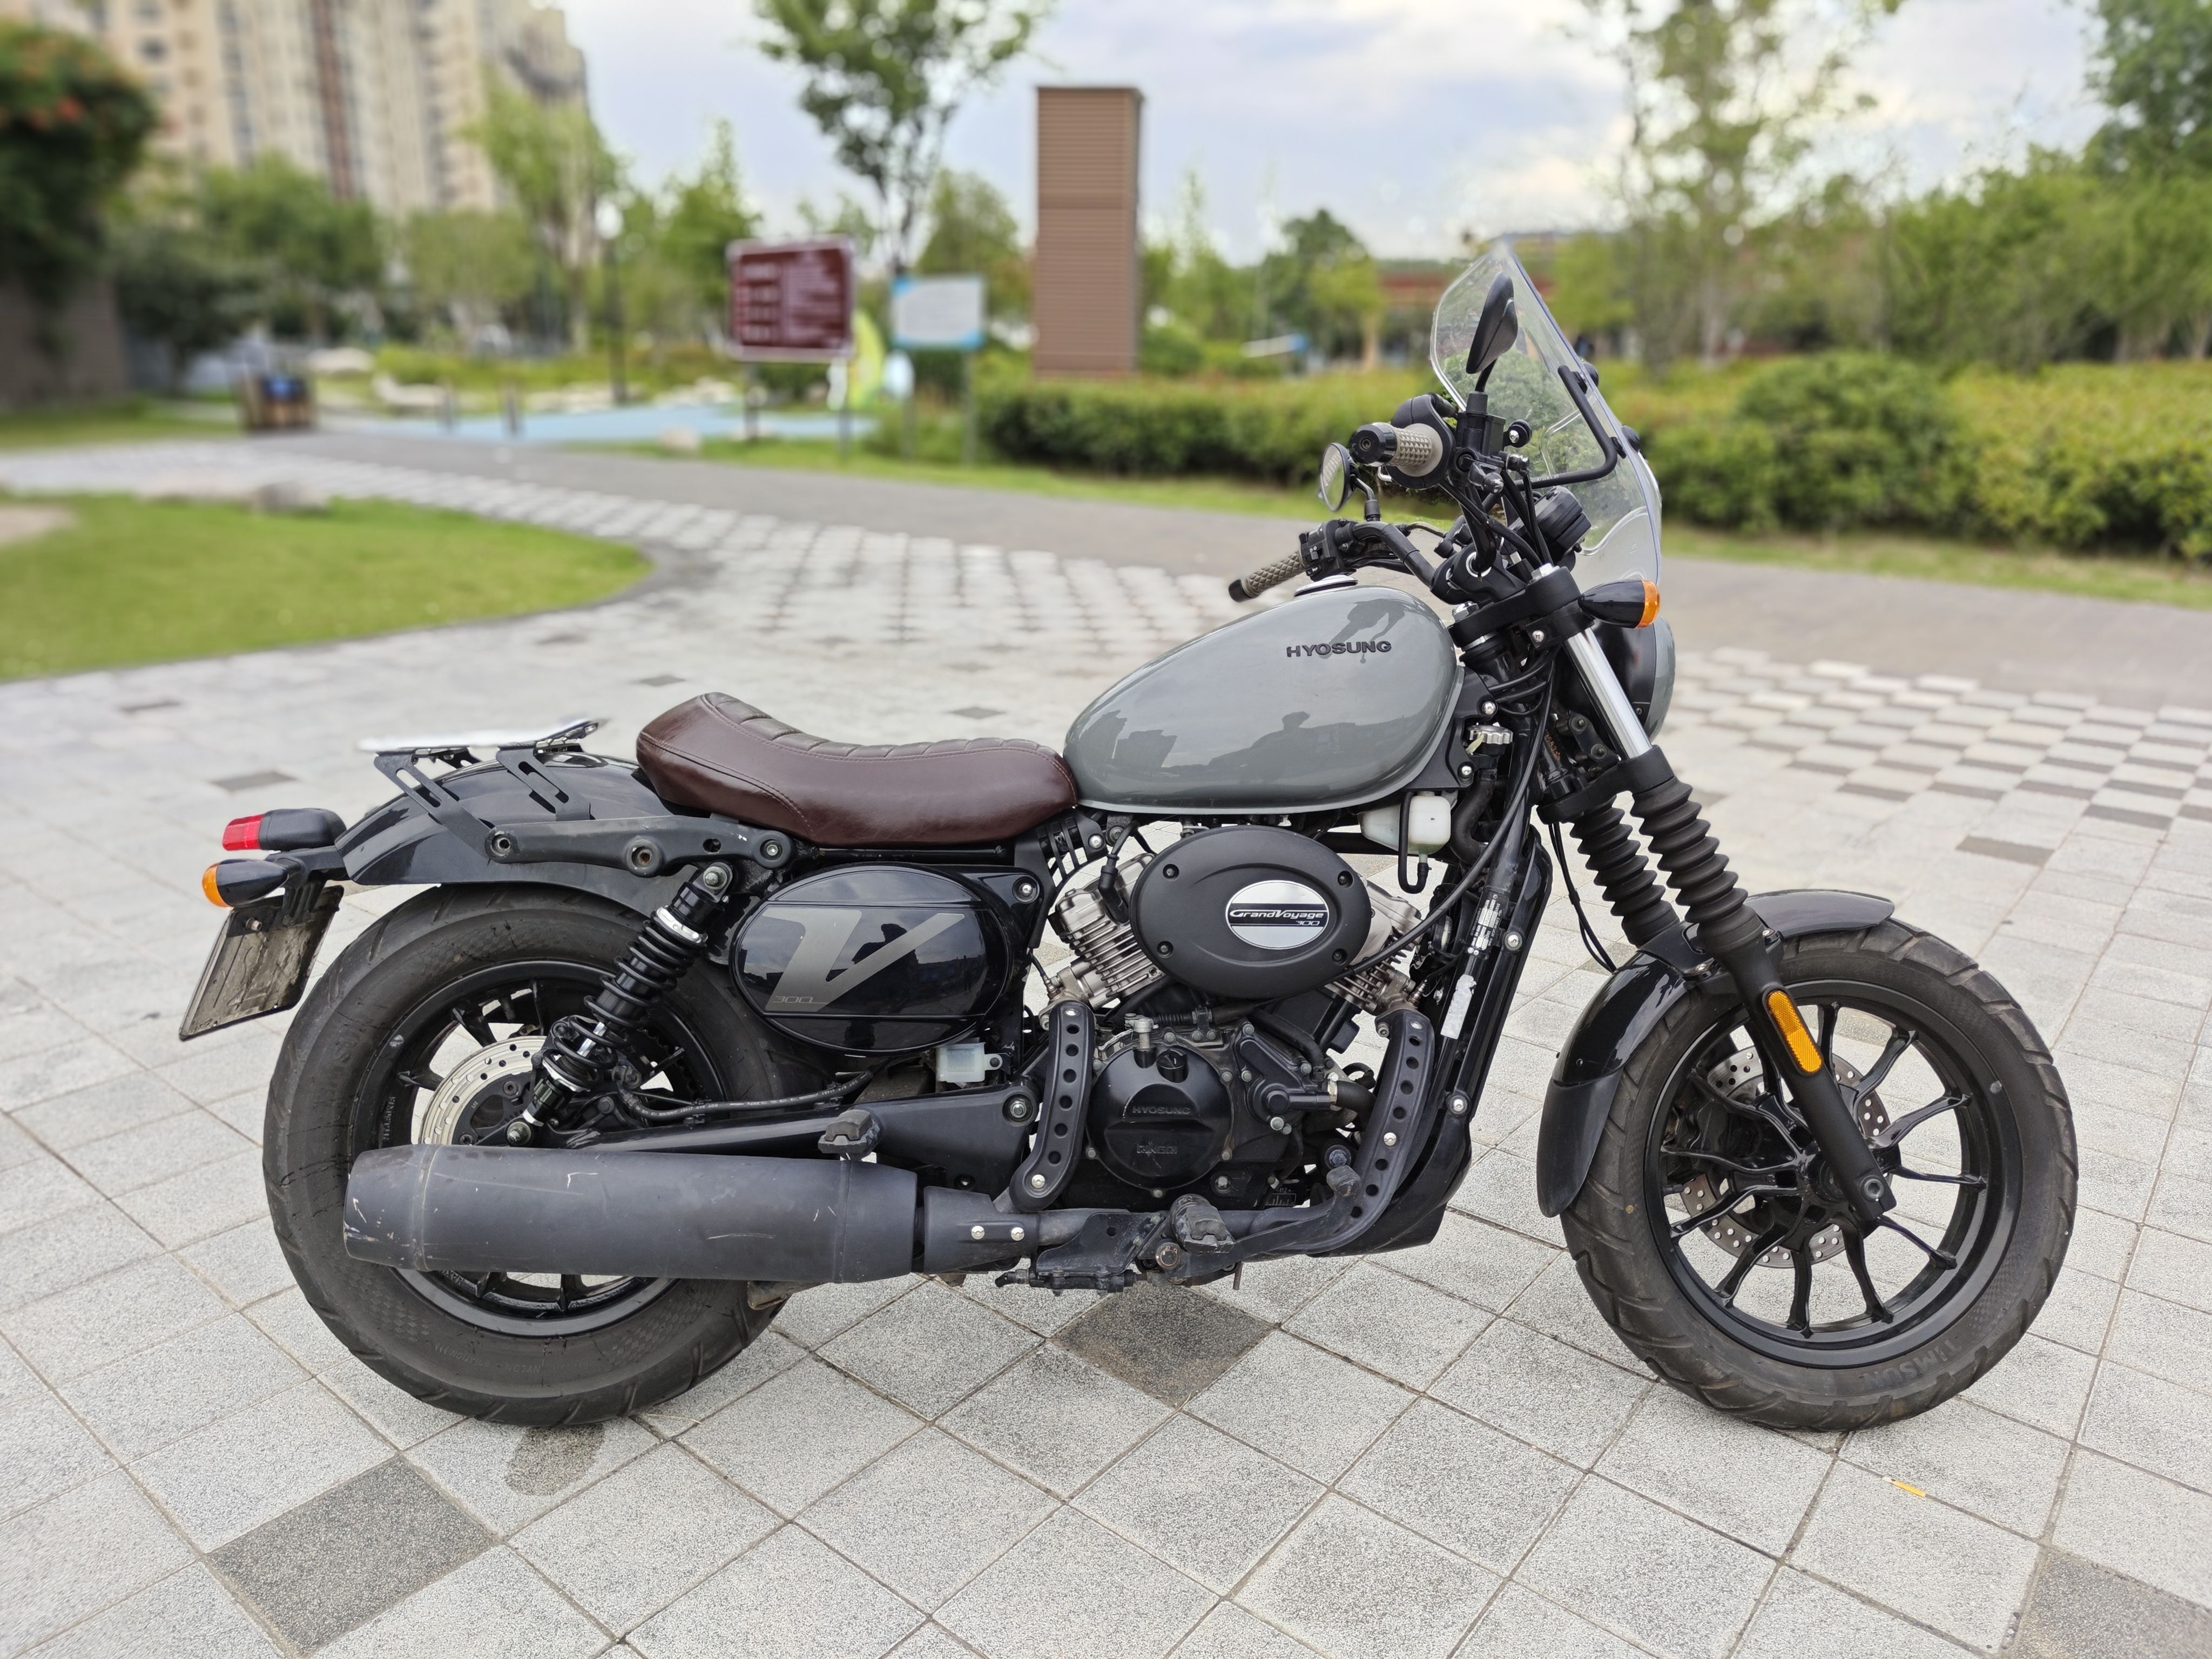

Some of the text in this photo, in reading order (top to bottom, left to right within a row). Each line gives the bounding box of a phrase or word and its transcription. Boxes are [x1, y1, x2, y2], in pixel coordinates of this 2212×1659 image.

[1286, 640, 1392, 657] HYOSUNG
[773, 995, 814, 1004] 300
[1132, 1106, 1191, 1115] HYOSUNG
